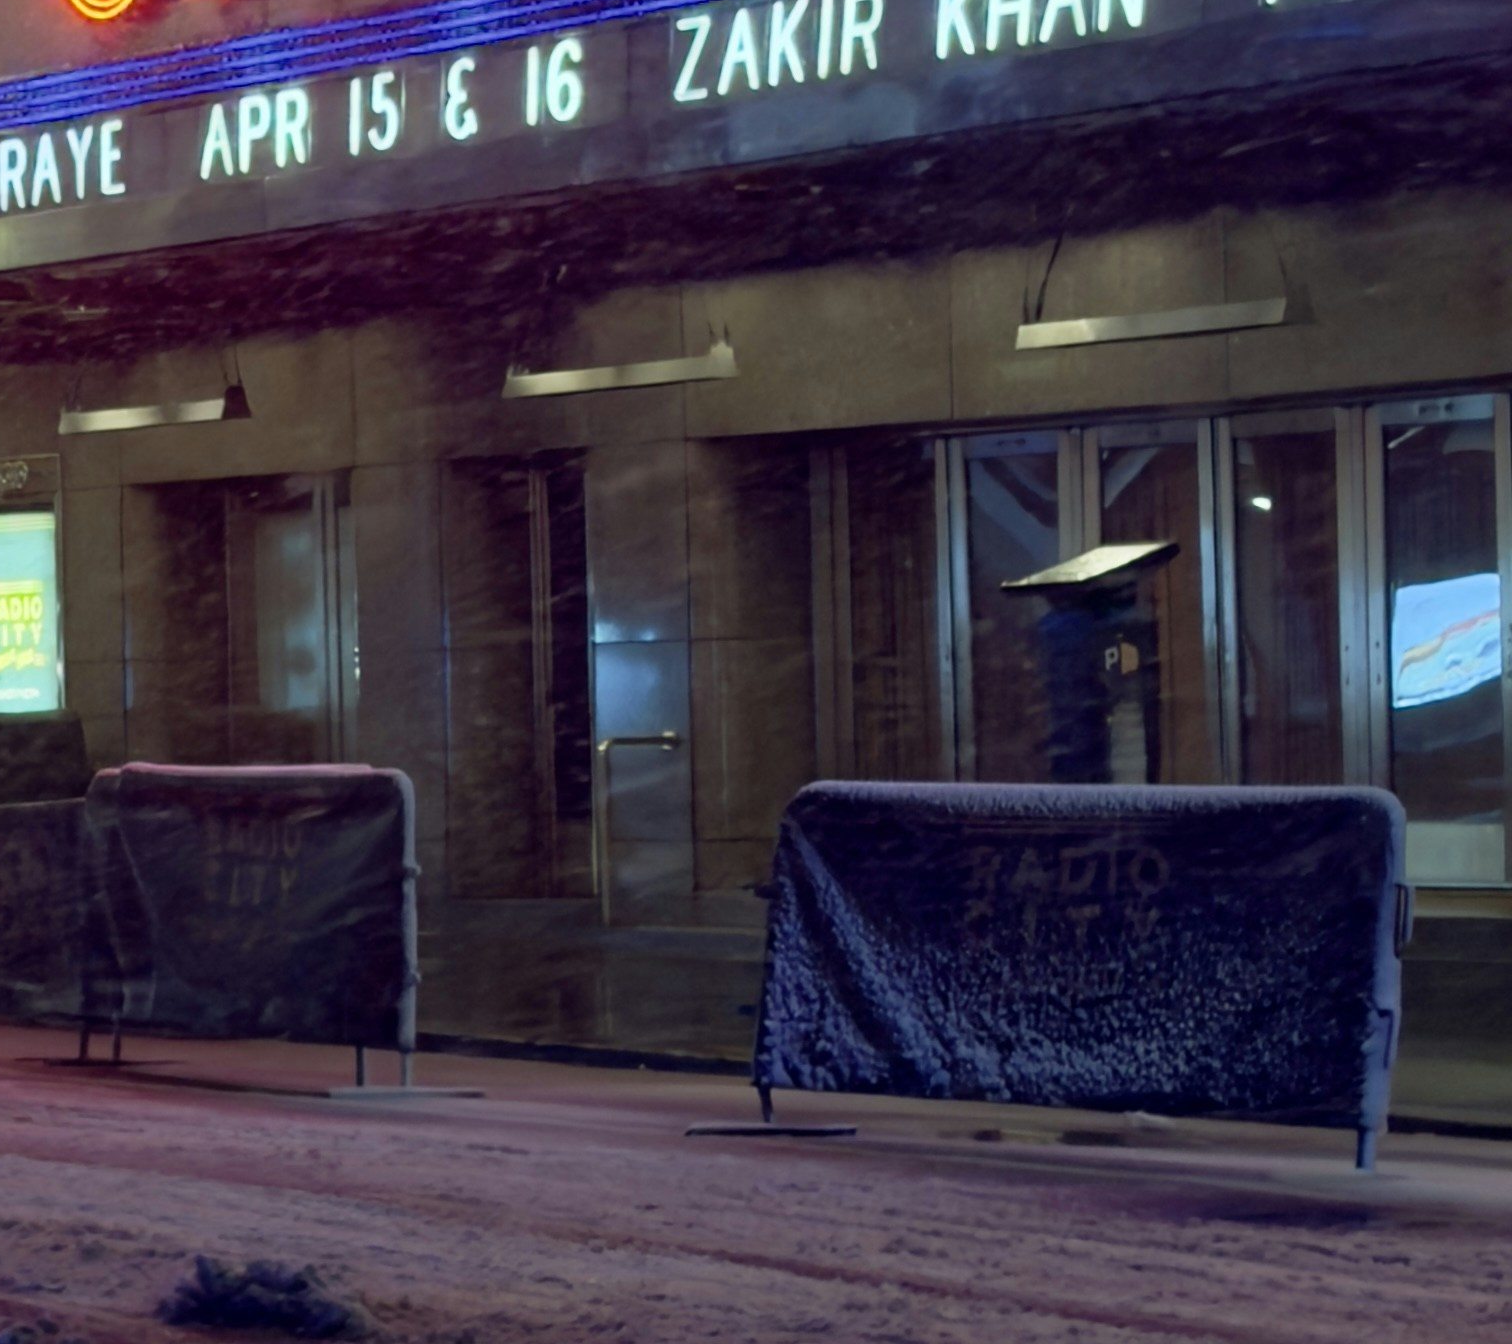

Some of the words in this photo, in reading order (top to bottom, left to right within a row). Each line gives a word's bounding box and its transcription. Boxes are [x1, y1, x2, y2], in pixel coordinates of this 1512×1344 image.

[199, 86, 311, 181] APR
[347, 70, 400, 157] 15
[525, 37, 584, 128] 16
